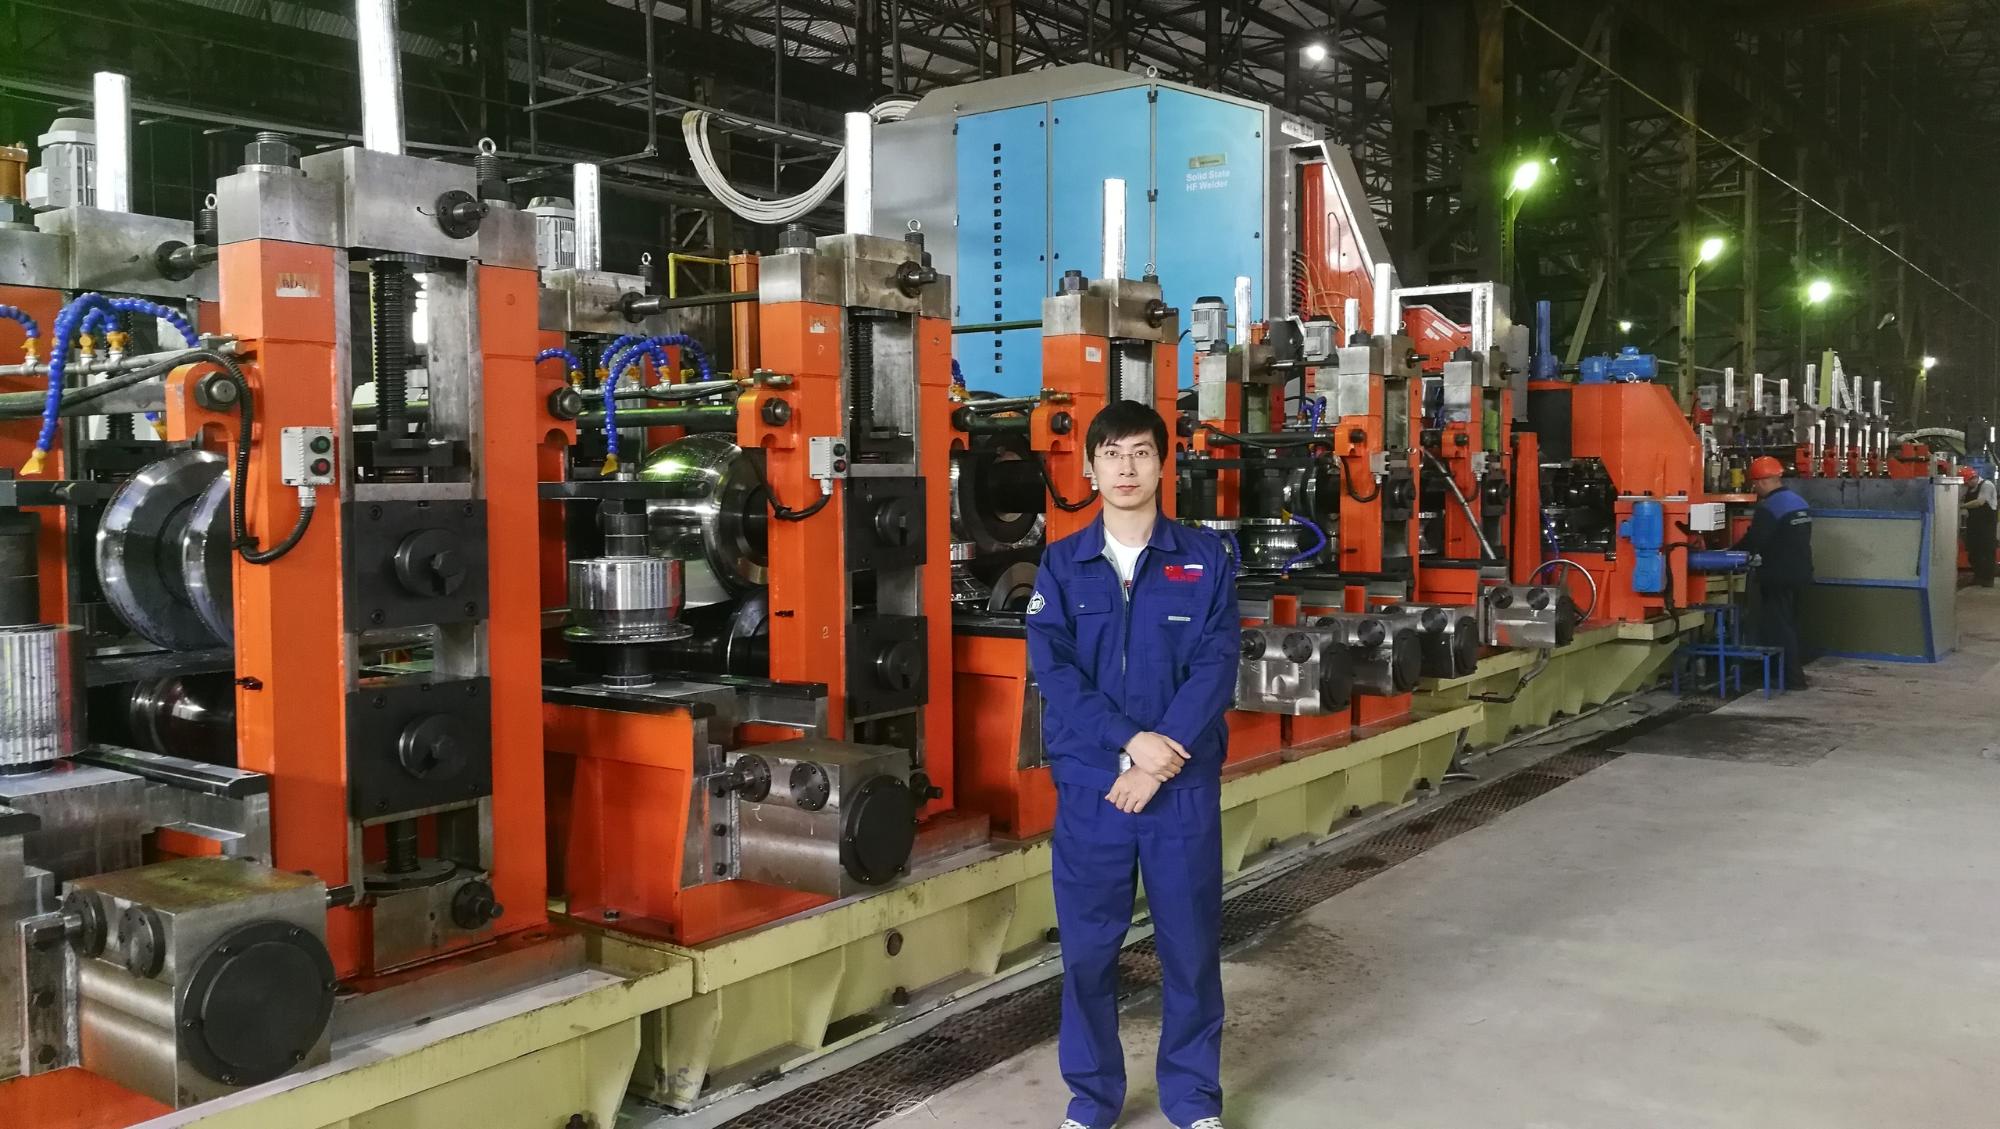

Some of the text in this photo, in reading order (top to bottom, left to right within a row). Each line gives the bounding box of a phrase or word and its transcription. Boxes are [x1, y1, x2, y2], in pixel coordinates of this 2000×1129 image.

[1186, 170, 1230, 181] Solid State
[1186, 180, 1228, 192] HF Welder
